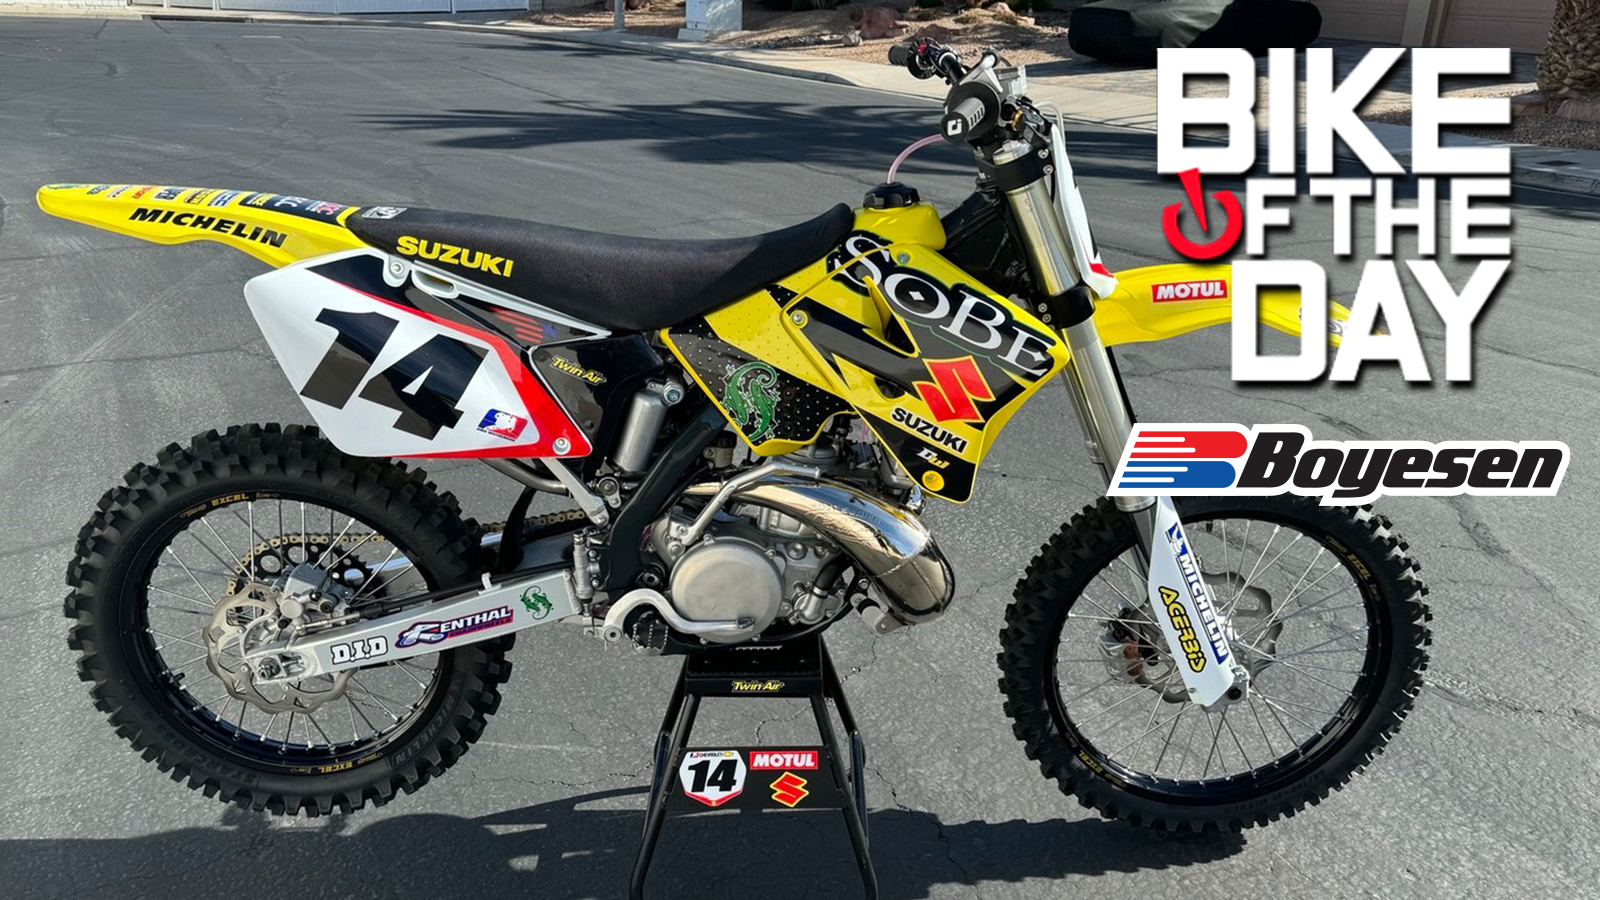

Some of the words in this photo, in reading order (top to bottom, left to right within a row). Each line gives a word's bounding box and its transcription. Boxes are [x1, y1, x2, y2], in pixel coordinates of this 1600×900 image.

[128, 207, 288, 249] MICHELIN
[396, 235, 514, 279] SUZUKI
[1156, 280, 1226, 300] MOTUL
[299, 307, 490, 441] 14
[553, 357, 583, 377] Twin
[582, 371, 604, 383] Air
[891, 407, 967, 454] SUZUKI
[210, 493, 250, 507] EXCEL
[1180, 554, 1228, 660] MICHELIN
[732, 680, 762, 691] Twin
[762, 681, 783, 691] Air
[395, 694, 454, 764] MICHELIN
[317, 761, 353, 773] EXCEL
[687, 759, 738, 793] 14
[752, 753, 815, 768] MOTUL
